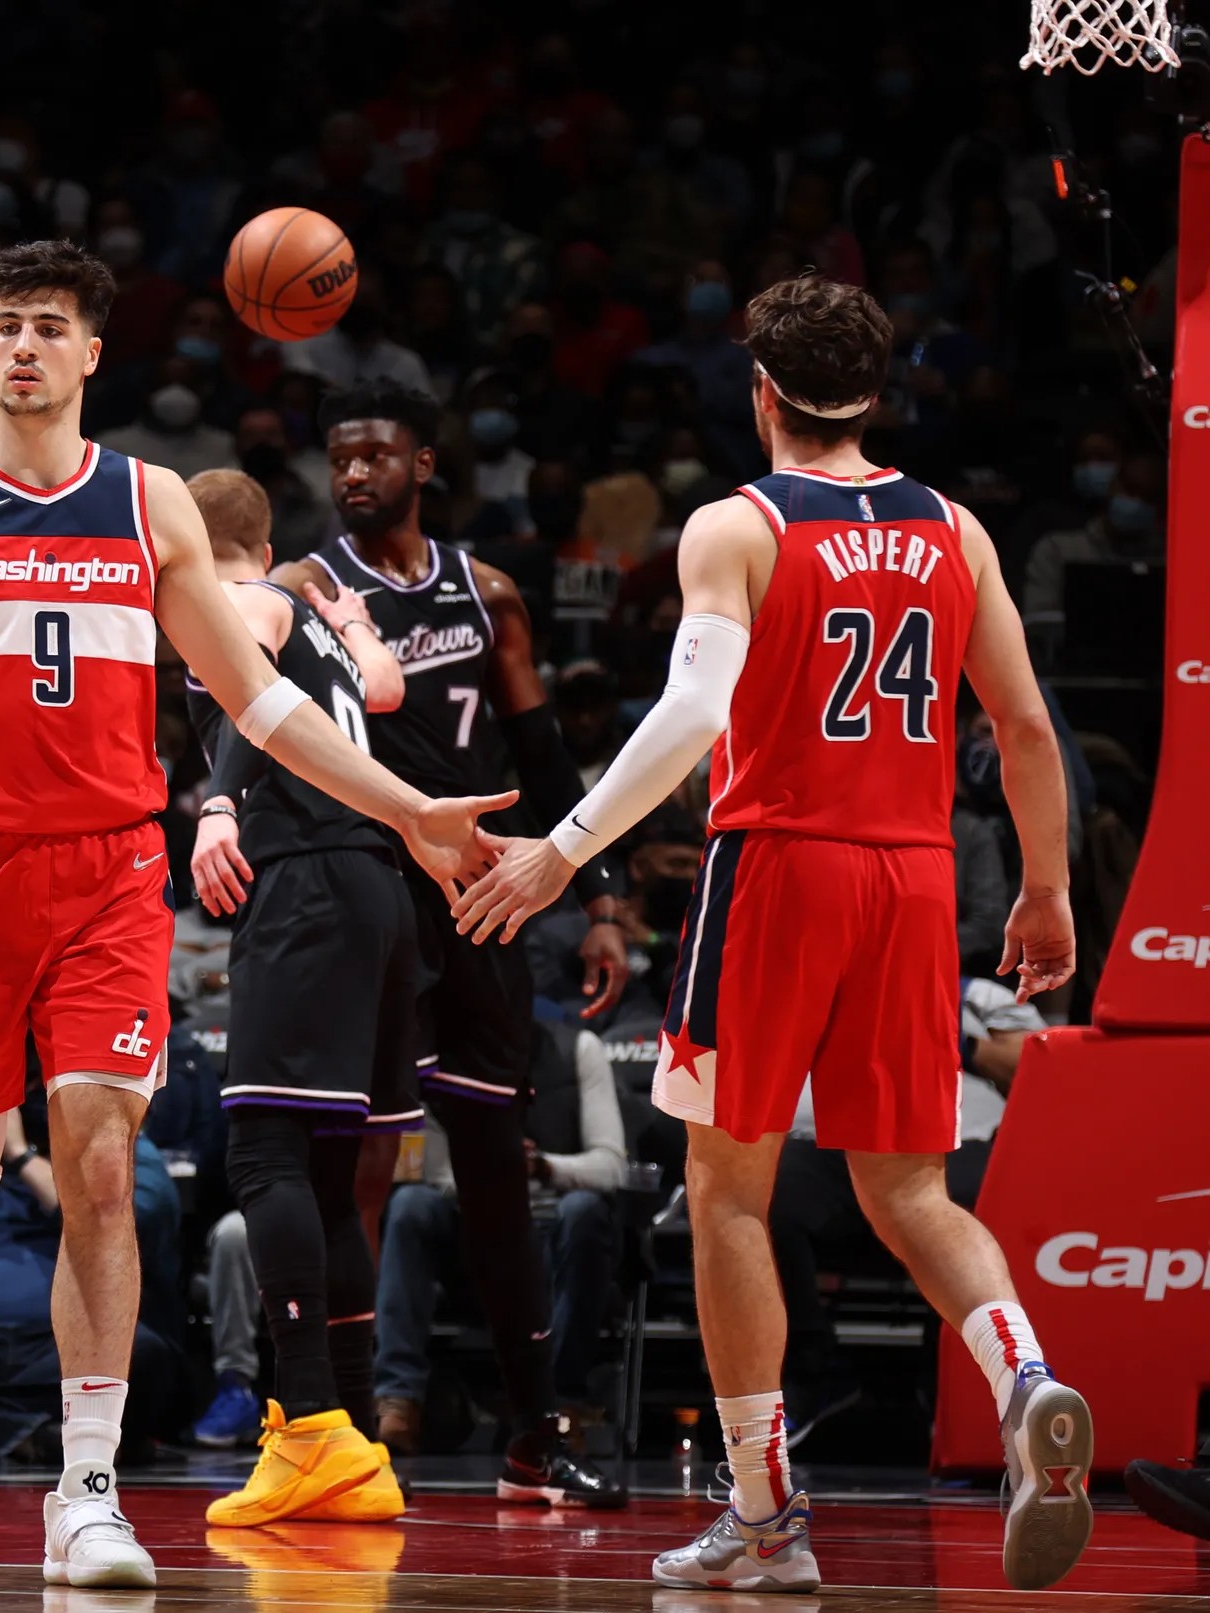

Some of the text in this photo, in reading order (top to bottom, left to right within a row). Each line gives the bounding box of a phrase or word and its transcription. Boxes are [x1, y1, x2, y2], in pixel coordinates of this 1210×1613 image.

[815, 528, 943, 585] KISPERT
[31, 610, 75, 708] 9
[821, 607, 939, 744] 24
[448, 687, 479, 748] 7
